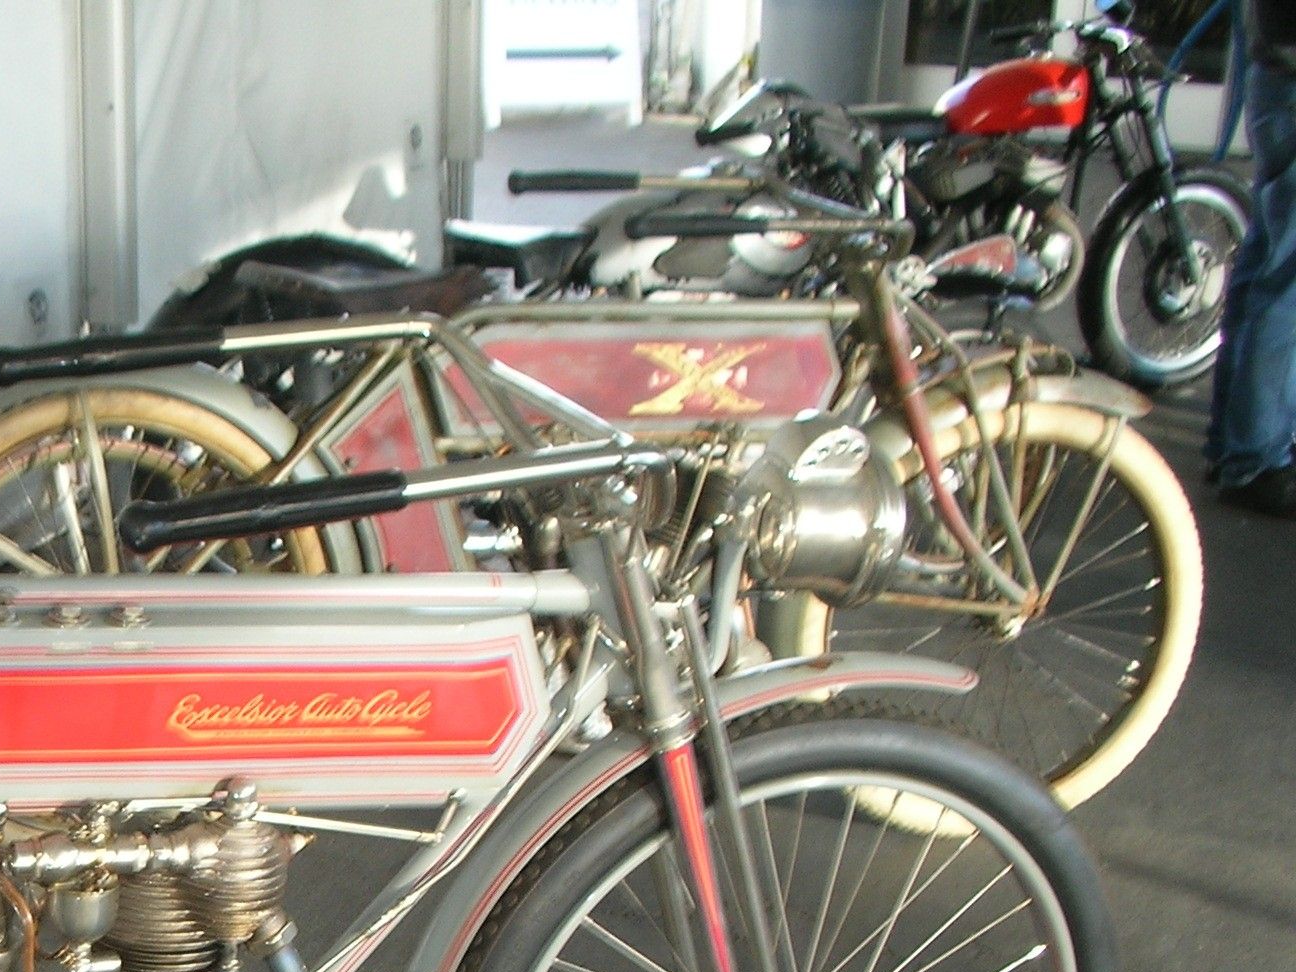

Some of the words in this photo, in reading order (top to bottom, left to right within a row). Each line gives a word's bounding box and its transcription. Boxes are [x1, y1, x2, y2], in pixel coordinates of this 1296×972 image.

[167, 693, 300, 729] Excelsior
[301, 692, 362, 721] Auto
[361, 689, 433, 725] Cycle
